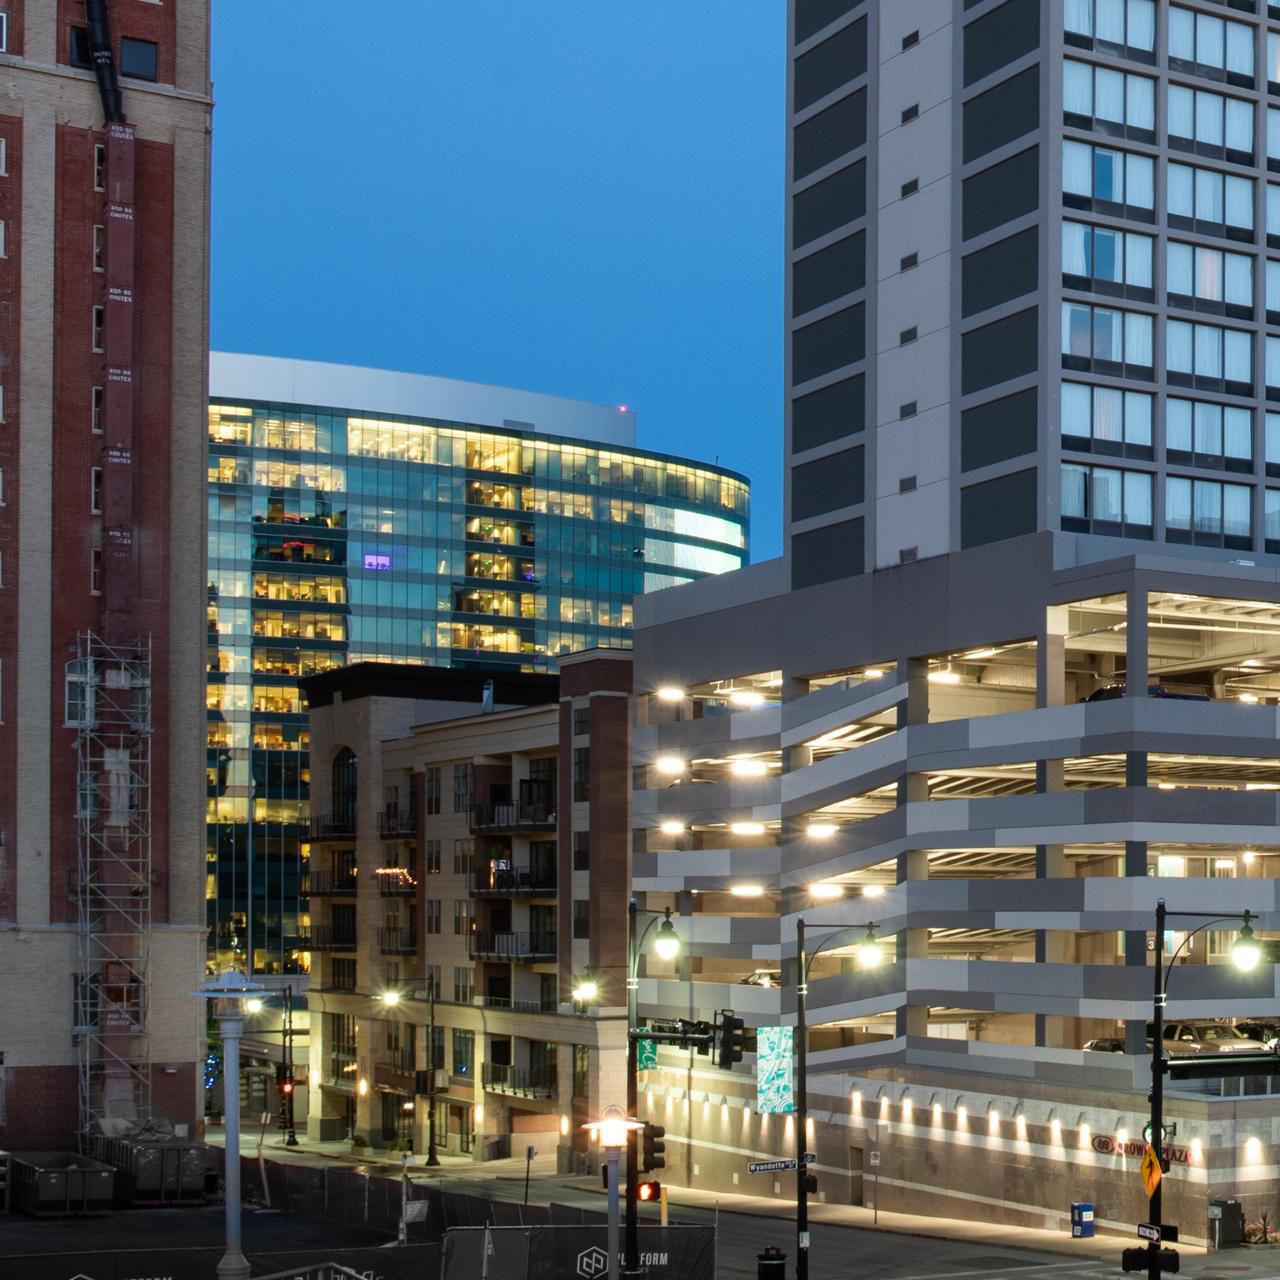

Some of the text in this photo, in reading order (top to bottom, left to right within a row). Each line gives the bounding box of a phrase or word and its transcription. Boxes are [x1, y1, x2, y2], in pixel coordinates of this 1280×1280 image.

[1148, 940, 1155, 950] 3
[750, 1163, 785, 1171] Wyandotte
[618, 1252, 668, 1266] LFORM
